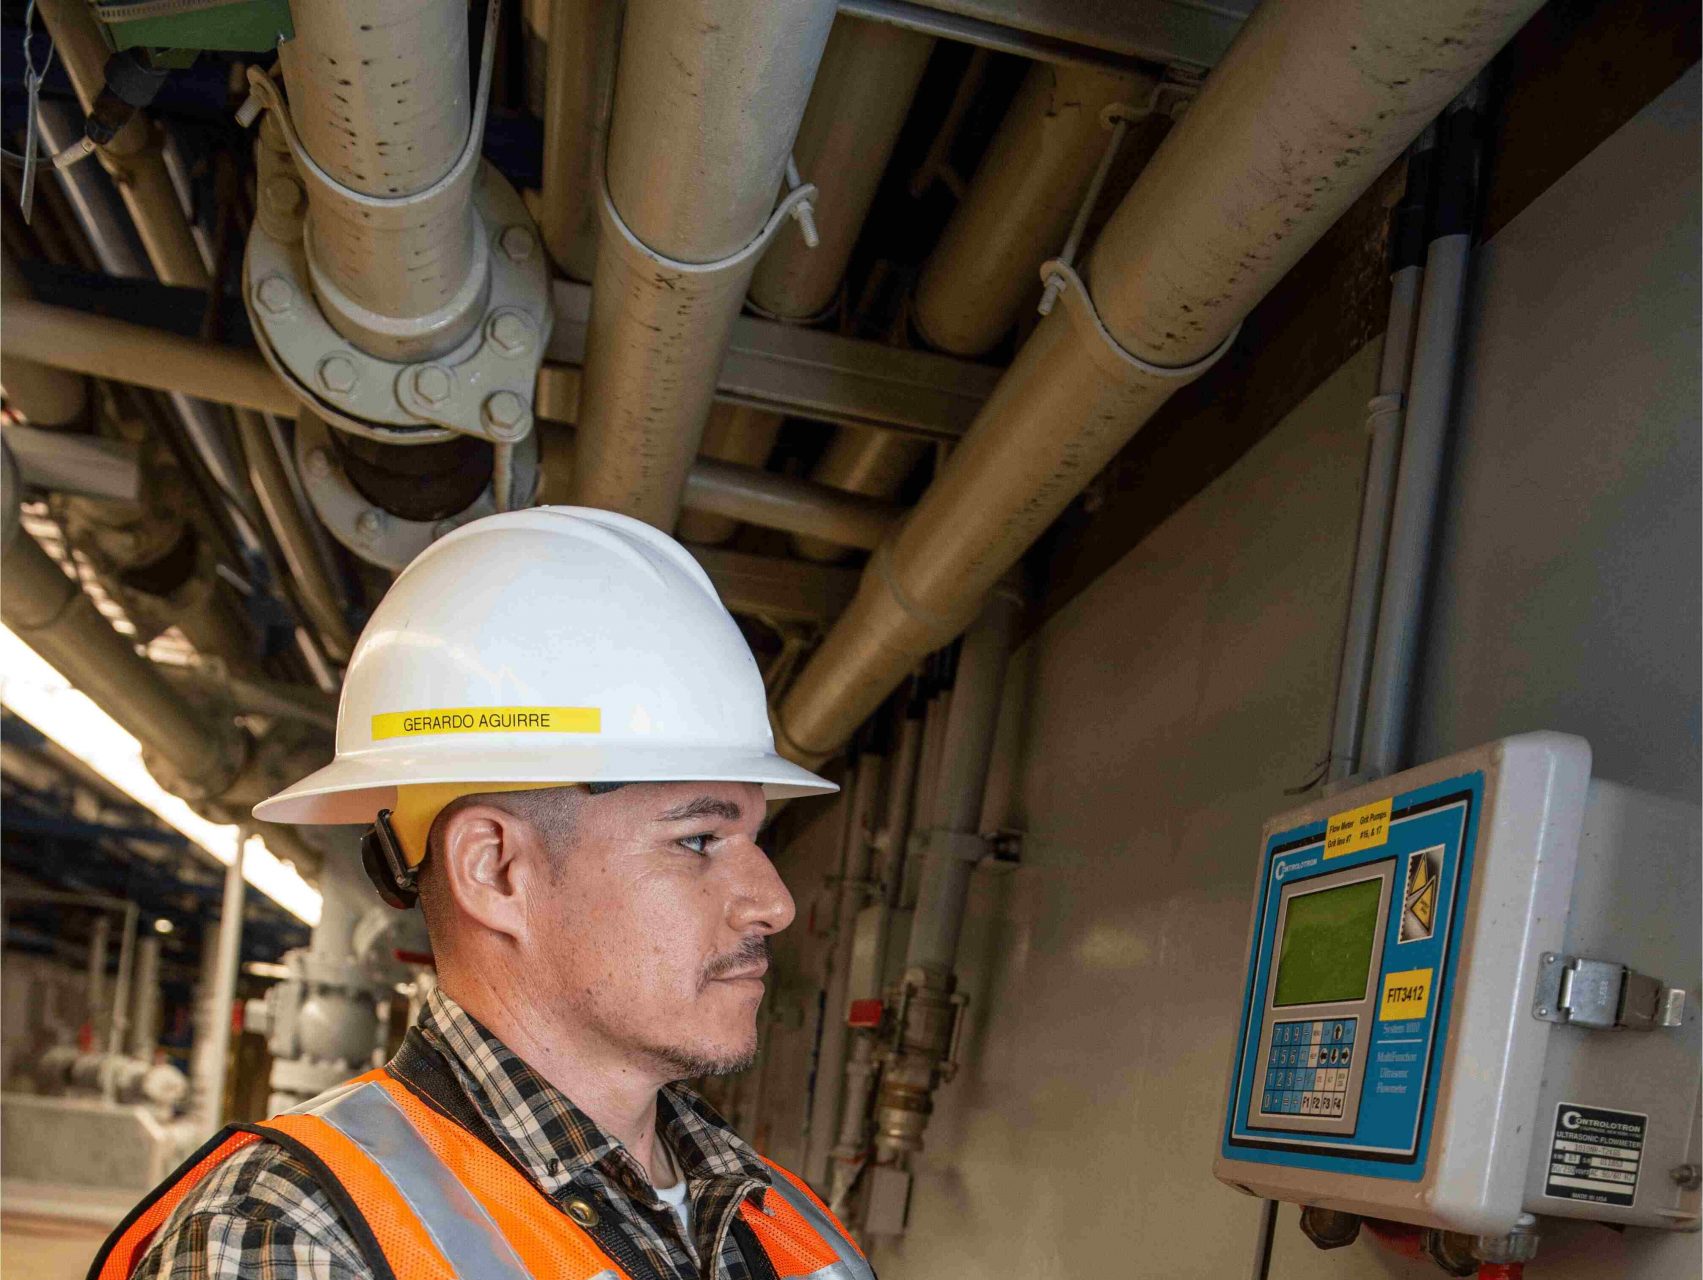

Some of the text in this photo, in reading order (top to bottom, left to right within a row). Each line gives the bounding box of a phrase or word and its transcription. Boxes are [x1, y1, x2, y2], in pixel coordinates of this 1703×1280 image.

[403, 713, 550, 732] GERARDO AGUIRRE
[1387, 985, 1424, 1003] FIT3412
[1275, 1028, 1282, 1040] 7
[1284, 1027, 1289, 1041] 8
[1294, 1027, 1299, 1041] 9
[1271, 1049, 1277, 1063] 4
[1280, 1050, 1287, 1064] 5
[1290, 1050, 1296, 1064] 6
[1276, 1072, 1283, 1087] 2
[1287, 1072, 1293, 1086] 3
[1264, 1094, 1341, 1109] 0 F1 F2 F3 F4
[1562, 1111, 1641, 1133] CONTROLOTRON
[1556, 1131, 1641, 1148] ULTRASONIC FLOWMETER
